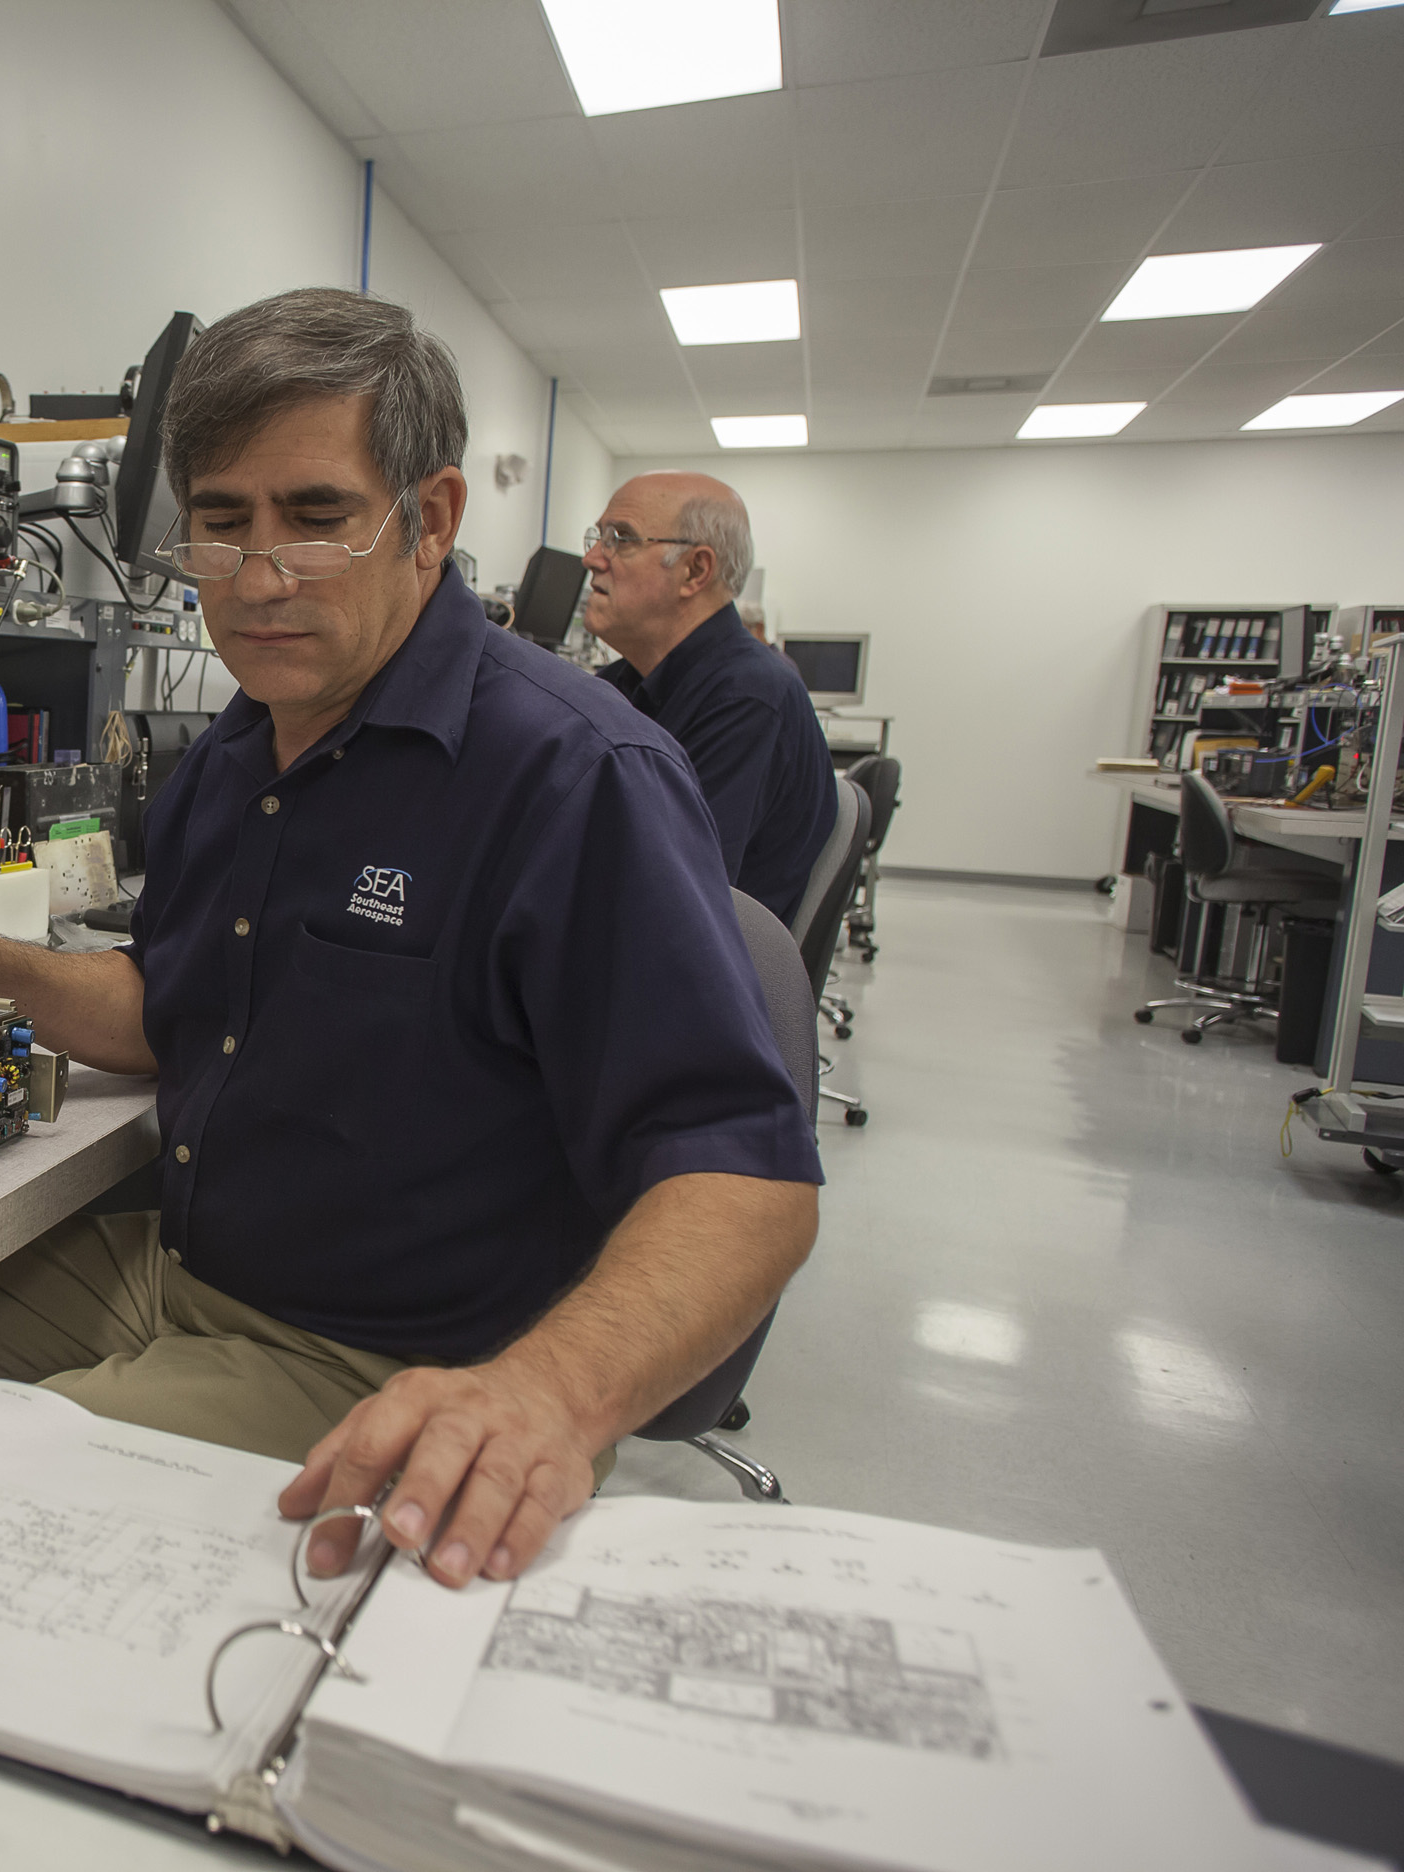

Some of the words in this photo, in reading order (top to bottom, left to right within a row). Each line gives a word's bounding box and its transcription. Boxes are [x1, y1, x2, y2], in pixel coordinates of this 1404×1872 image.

[358, 865, 404, 901] SEA
[346, 904, 403, 926] Aerospace
[350, 893, 404, 916] Southeast
